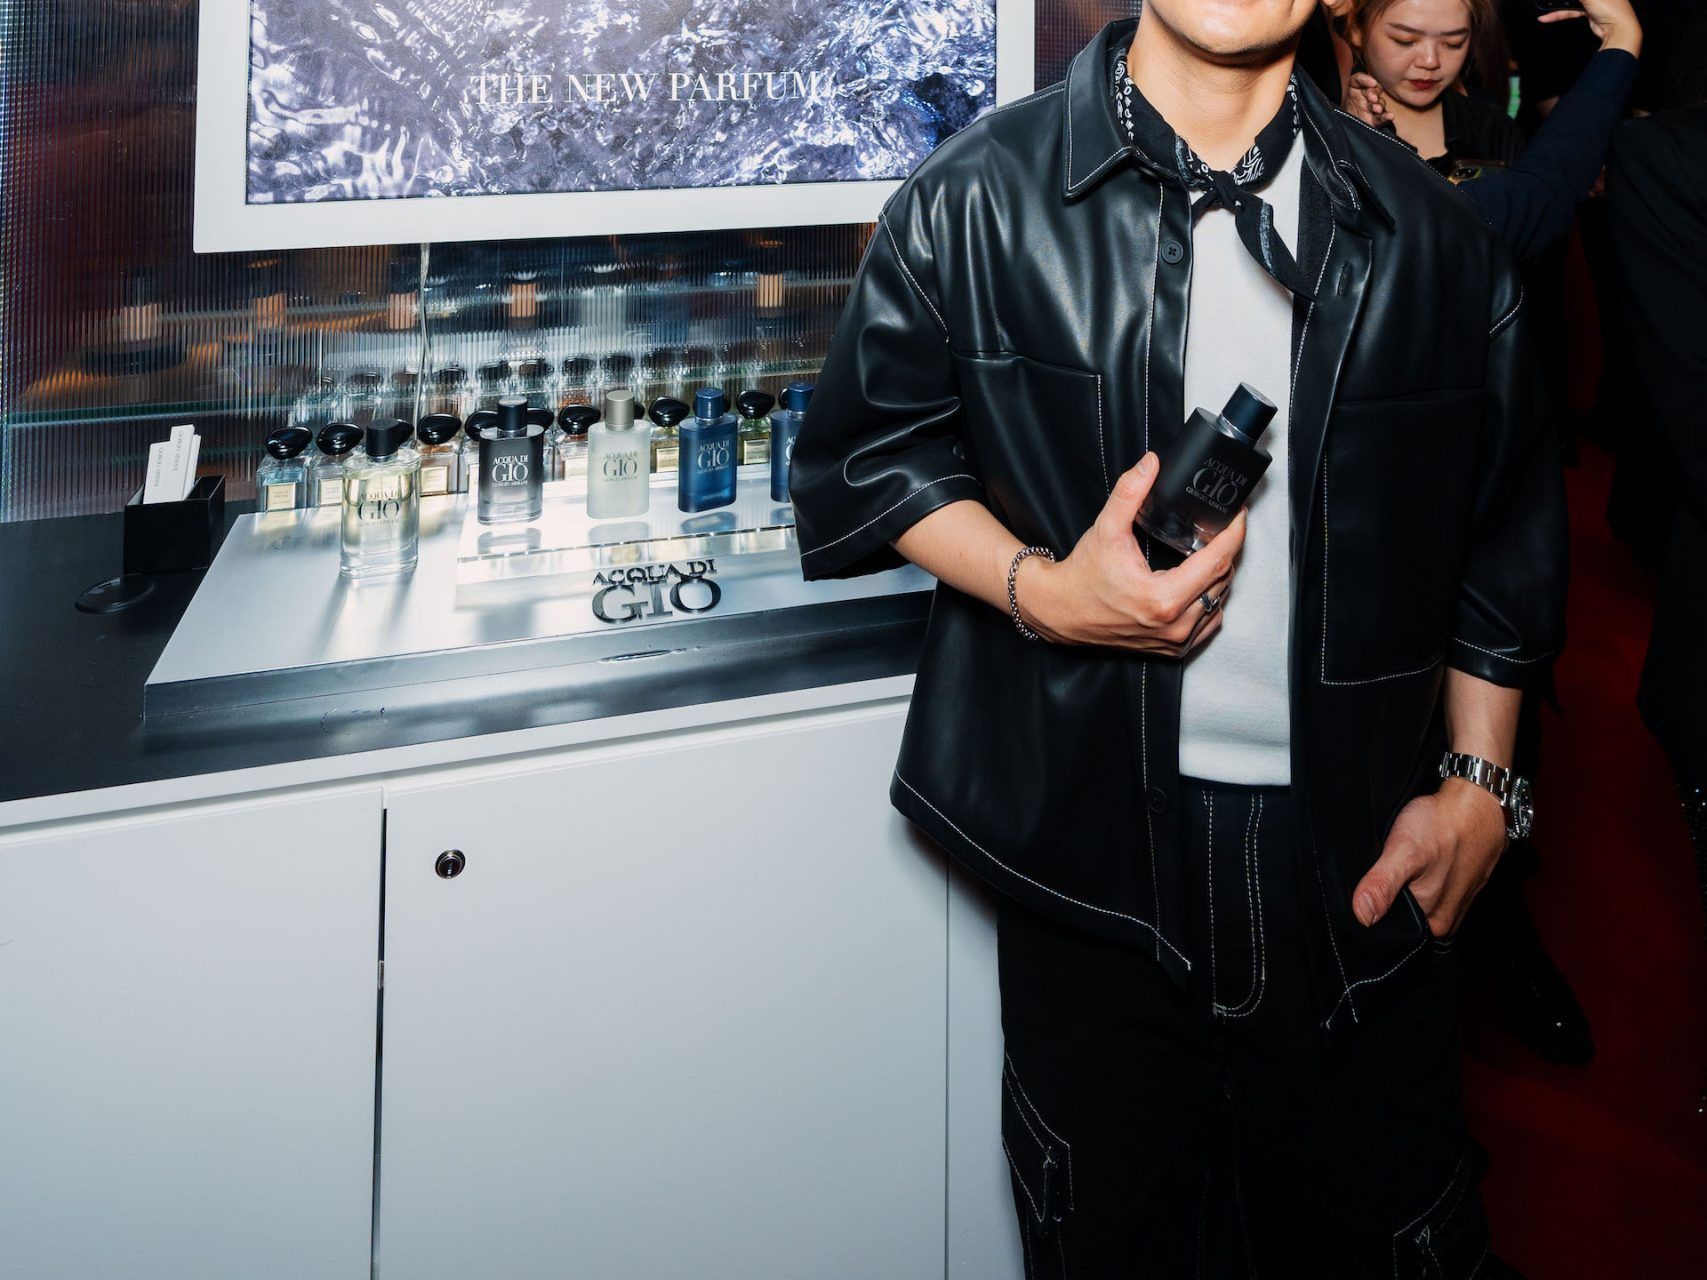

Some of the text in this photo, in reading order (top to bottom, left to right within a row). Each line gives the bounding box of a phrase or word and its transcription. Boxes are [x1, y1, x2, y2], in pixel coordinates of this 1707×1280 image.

[470, 71, 819, 104] THE NEW PARFUM
[493, 455, 528, 465] ACQUA DI
[1203, 457, 1248, 487] ACQUA DI
[593, 559, 717, 586] ACQUA DI
